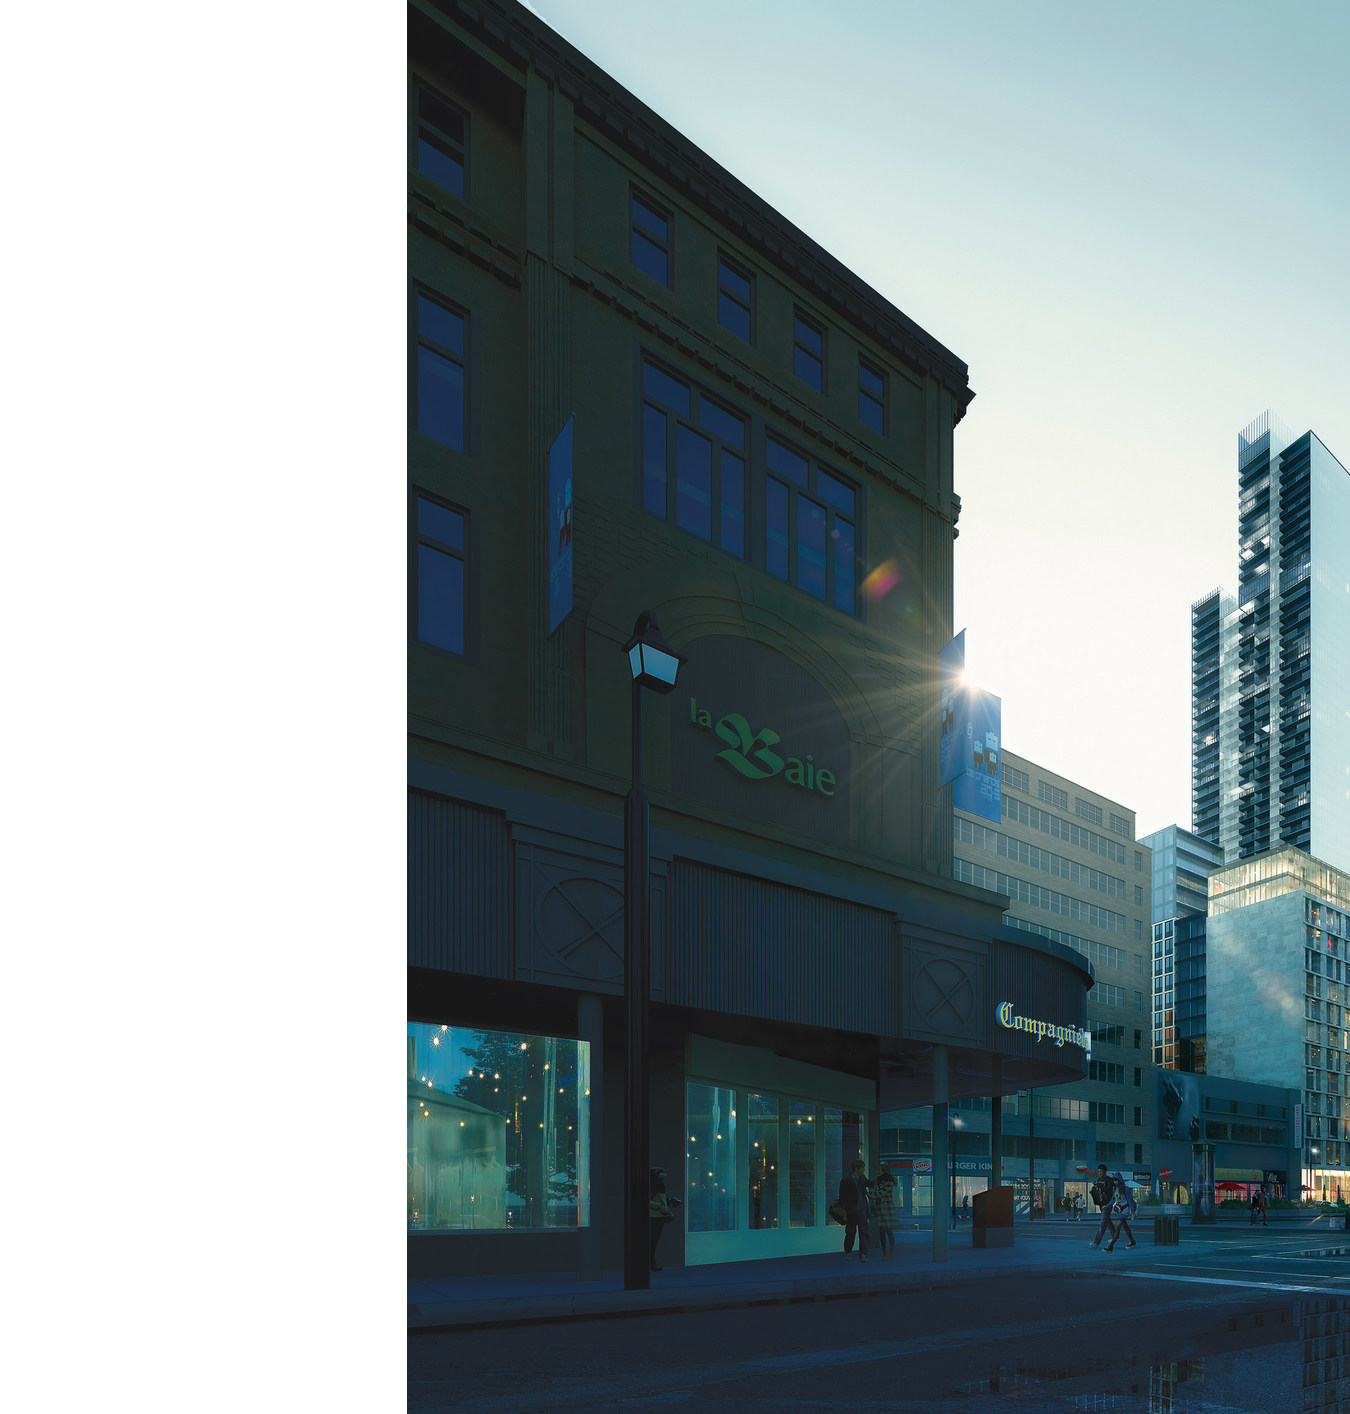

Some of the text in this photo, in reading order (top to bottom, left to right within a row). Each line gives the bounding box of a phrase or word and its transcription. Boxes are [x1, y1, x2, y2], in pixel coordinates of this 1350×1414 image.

[689, 696, 836, 796] la Baie
[995, 1001, 1081, 1047] Compagnie
[947, 1161, 993, 1171] URGER KIN
